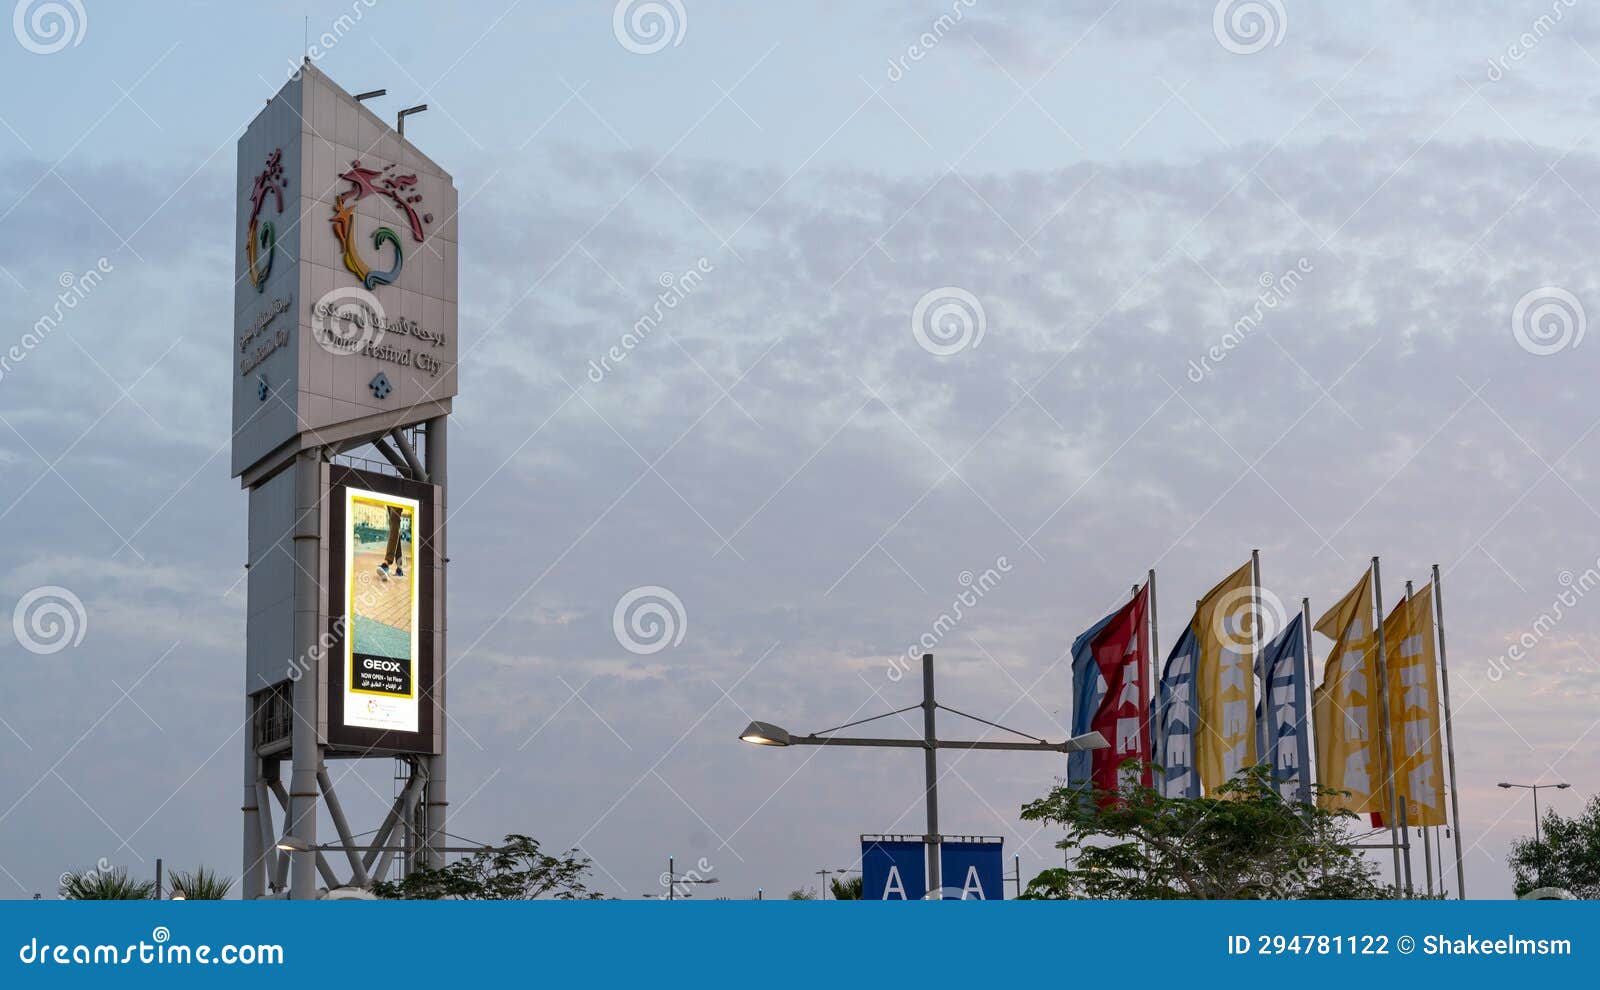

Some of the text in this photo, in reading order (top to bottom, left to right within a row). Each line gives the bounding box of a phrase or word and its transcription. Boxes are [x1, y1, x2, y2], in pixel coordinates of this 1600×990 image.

[361, 339, 412, 368] Festival
[415, 351, 442, 377] City
[363, 659, 401, 673] GEOX
[372, 673, 384, 681] OPEN
[1342, 618, 1371, 795] IKEA
[1400, 634, 1437, 809] IKEA
[882, 865, 907, 900] A
[961, 865, 986, 900] A
